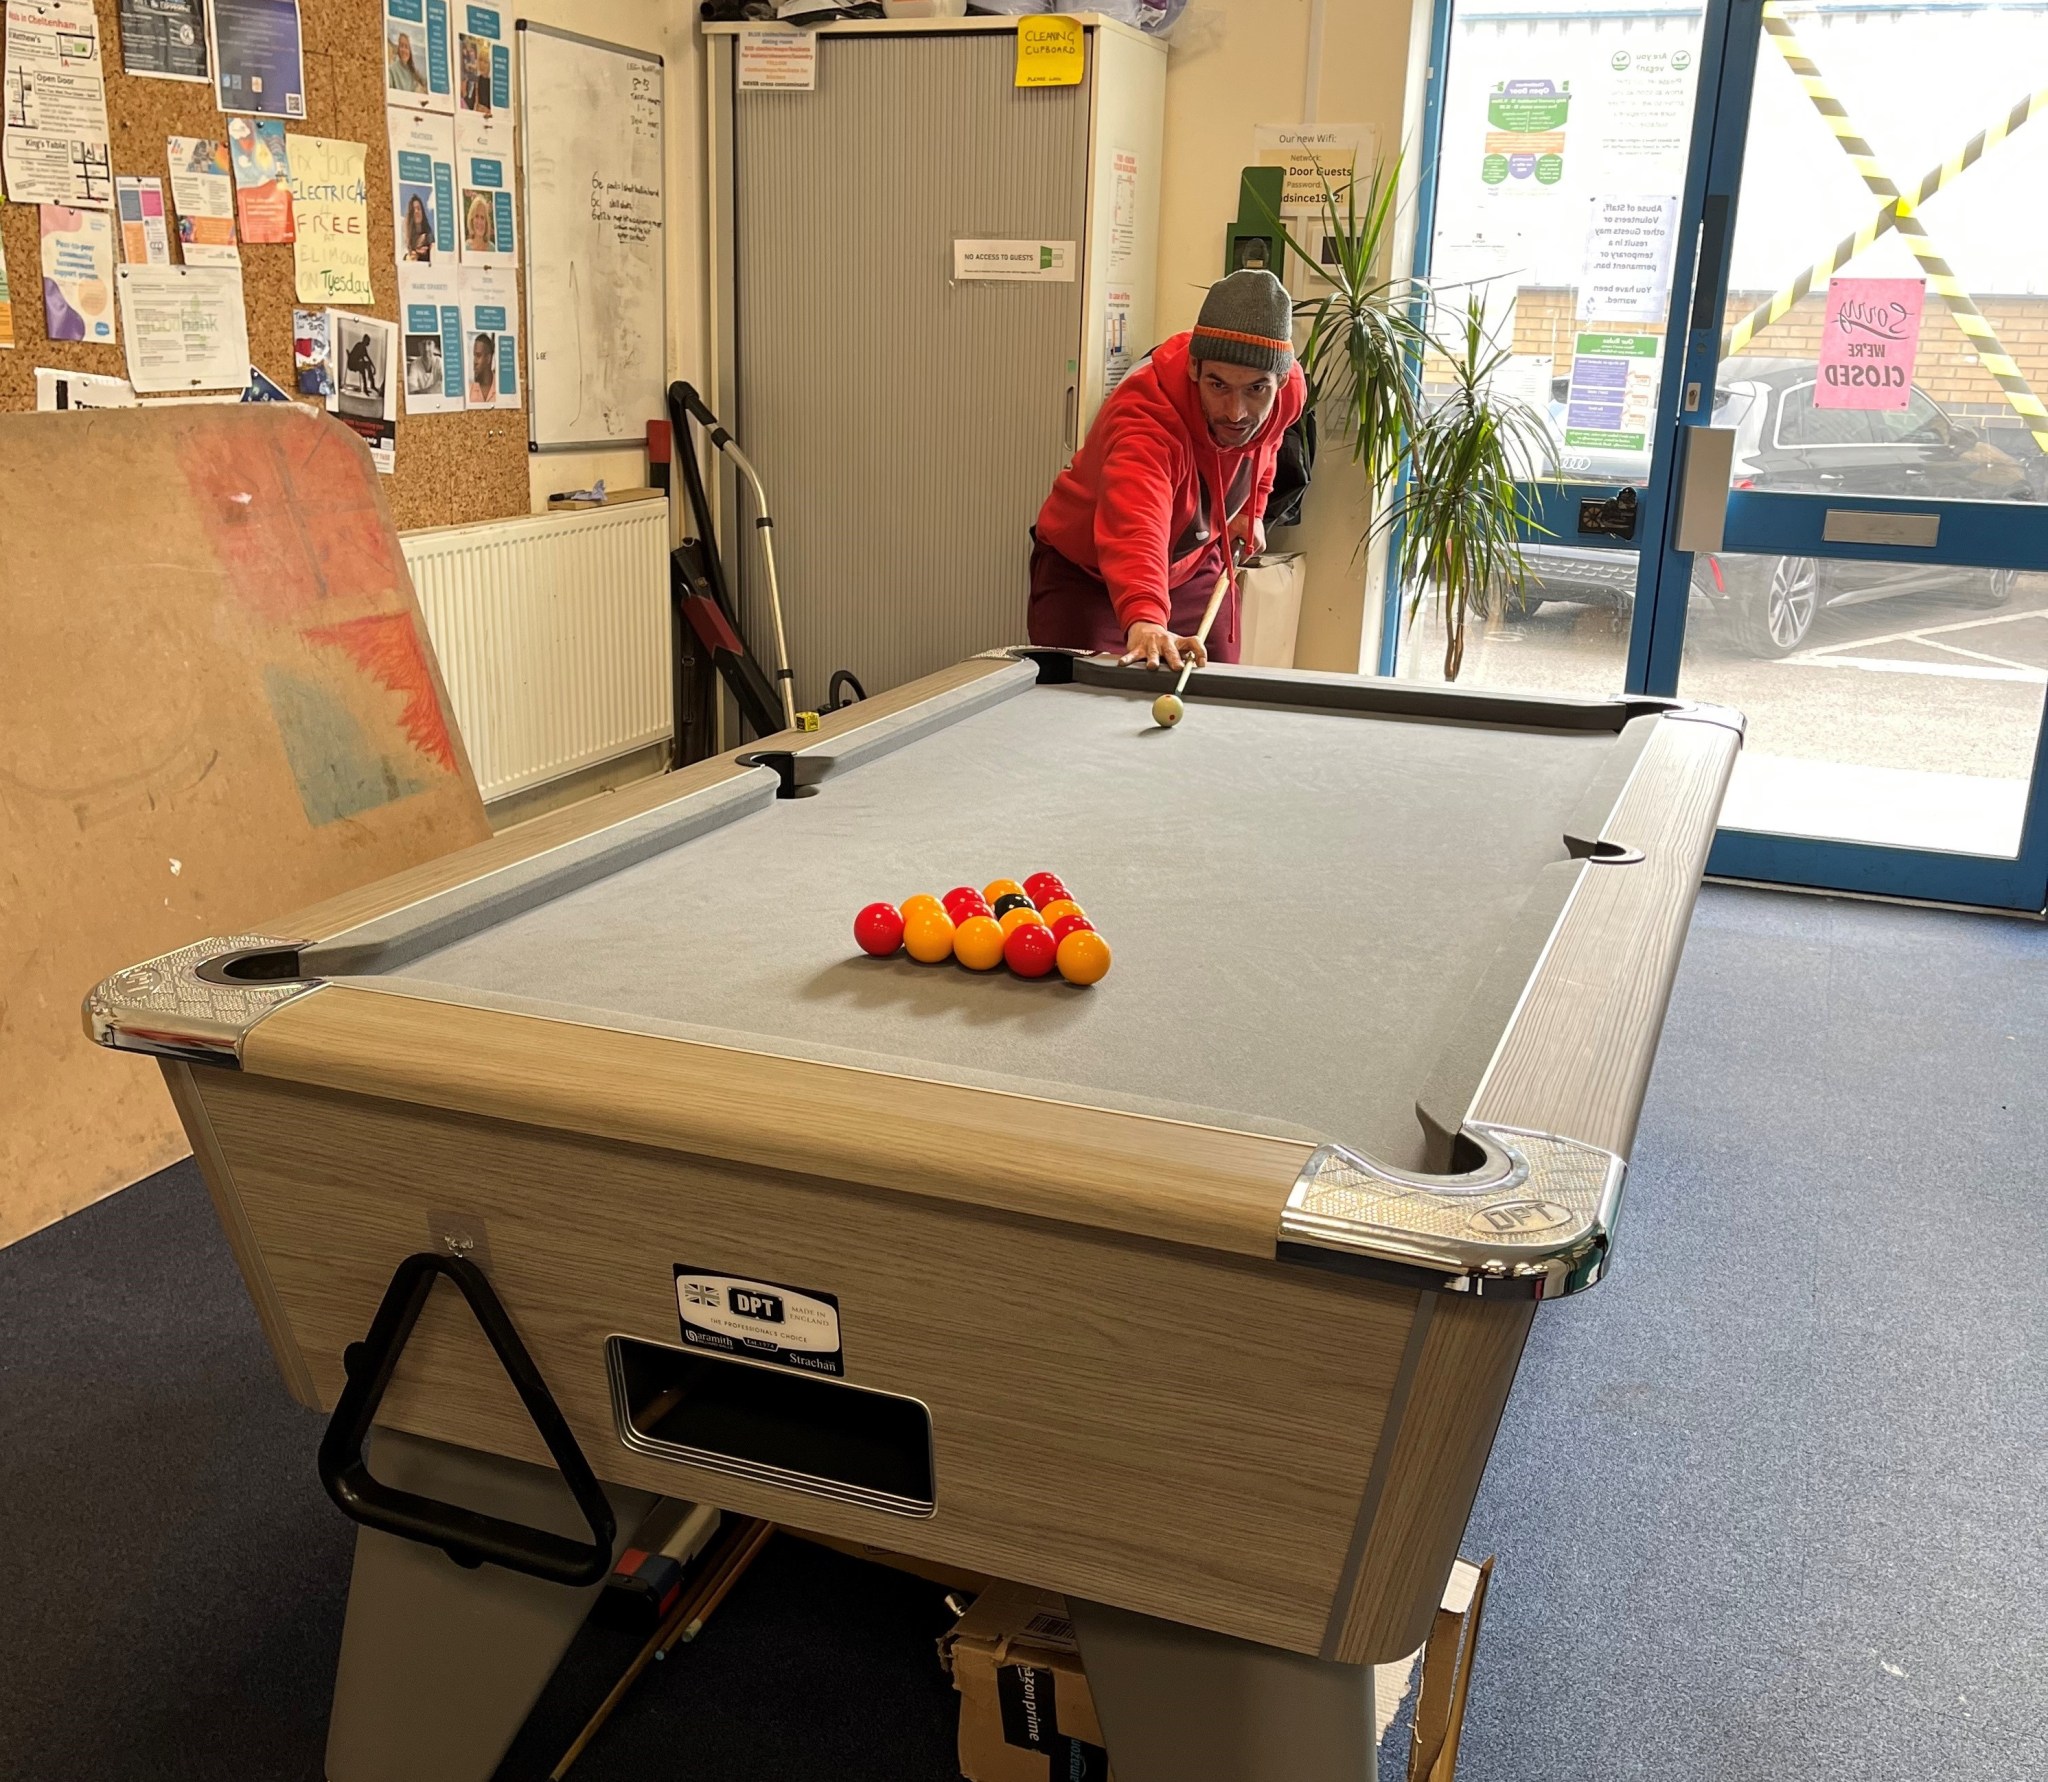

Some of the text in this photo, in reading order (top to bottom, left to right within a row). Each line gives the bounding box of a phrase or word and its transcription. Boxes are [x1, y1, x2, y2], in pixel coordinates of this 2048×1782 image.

[28, 15, 77, 30] Cheltenham
[1025, 45, 1075, 55] CUPBOARD
[36, 73, 74, 85] Open Door
[1279, 135, 1296, 143] Our
[1316, 134, 1337, 143] Wifi:
[1289, 167, 1314, 177] Door
[1316, 167, 1352, 177] Guests
[1286, 181, 1322, 189] Password:
[1280, 193, 1344, 203] dsince192!
[297, 213, 361, 234] FREE
[964, 253, 974, 261] NO
[975, 253, 1000, 261] ACCESS
[1009, 254, 1034, 262] GUESTS
[321, 270, 371, 302] Tuesday
[1482, 1203, 1554, 1230] DPT
[737, 1294, 774, 1317] DPT
[791, 1306, 815, 1316] MADE
[790, 1314, 830, 1327] ENGLAND
[697, 1332, 733, 1347] aramith
[780, 1332, 808, 1343] CHOICE
[789, 1352, 836, 1372] Strachan
[1069, 1739, 1081, 1782] amazon
